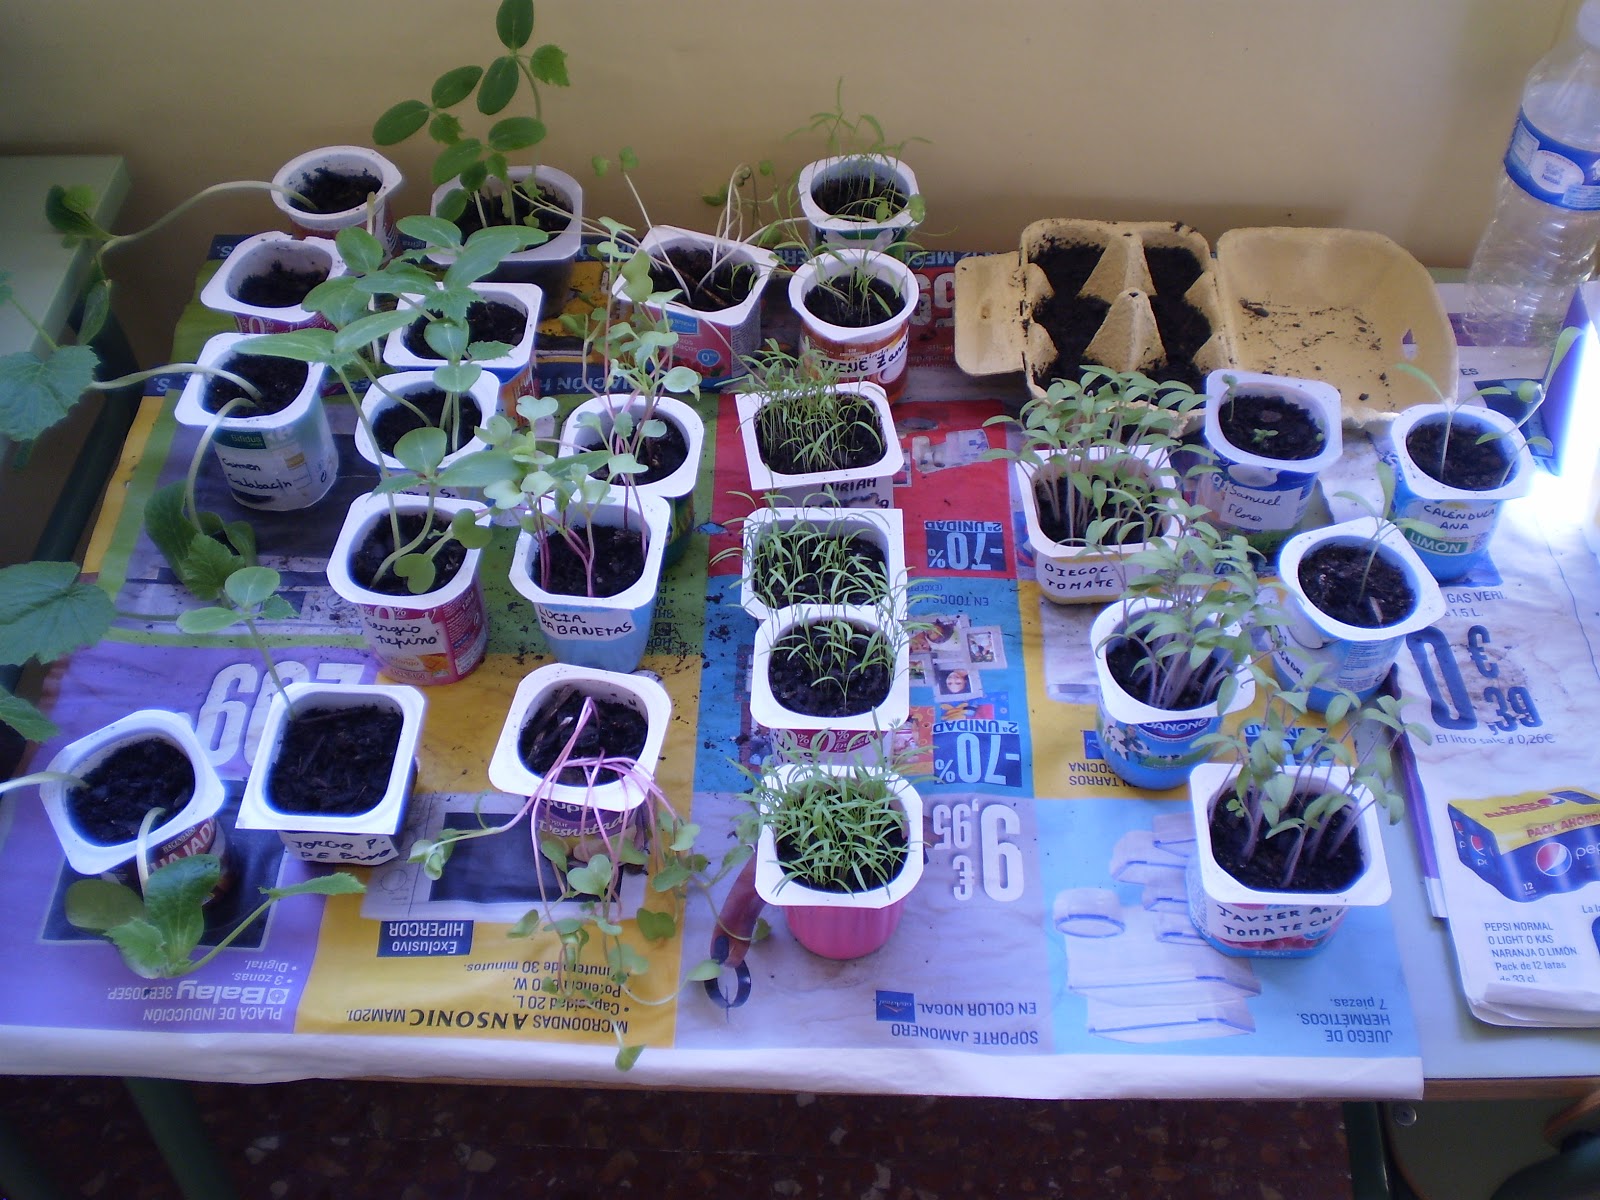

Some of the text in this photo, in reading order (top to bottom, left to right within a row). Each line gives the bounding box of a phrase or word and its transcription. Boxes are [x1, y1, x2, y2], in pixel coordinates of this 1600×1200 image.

[925, 521, 985, 532] UNIDAD
[1440, 521, 1469, 530] ANA
[927, 532, 1003, 570] -70%
[1046, 578, 1114, 590] TOMATE
[974, 596, 989, 606] EN
[1447, 593, 1472, 603] GAS
[932, 719, 999, 734] UNIDAD
[1451, 734, 1476, 744] litro
[934, 732, 1020, 785] -70%
[1069, 775, 1119, 787] TARROS
[1526, 824, 1556, 838] PACK
[980, 804, 1025, 902] 9
[952, 854, 974, 901] €
[1523, 882, 1534, 890] 12
[1217, 904, 1300, 922] JAVIER
[389, 922, 464, 937] HIPERCOR
[1224, 922, 1303, 937] TOMATE
[1484, 922, 1554, 931] PEPSI NORMAL
[1497, 935, 1524, 945] LIGHT
[1526, 935, 1533, 944] O
[1535, 935, 1554, 943] KAS
[392, 941, 457, 954] Exclusivo
[1492, 948, 1537, 958] NARANJA
[1539, 948, 1545, 956] O
[244, 959, 288, 972] Digital.
[464, 960, 519, 973] minutos.
[522, 961, 540, 973] 30
[543, 961, 559, 975] de
[1495, 961, 1567, 971] Pack de 12 latas
[231, 972, 283, 985] 3 zonas.
[512, 977, 528, 990] W.
[176, 980, 266, 1004] Balay
[512, 995, 524, 1008] L.
[527, 996, 546, 1009] 20
[1329, 997, 1385, 1010] 7 piezas.
[143, 1007, 283, 1024] PLACA DE INDUCCIÓN
[917, 1002, 1037, 1016] EN COLOR NOGAL
[409, 1008, 528, 1030] ANSONIC
[533, 1015, 629, 1035] MICROONDAS
[1296, 1013, 1391, 1028] HERMÉTICOS.
[890, 1023, 1038, 1045] SOPORTE JAMONERO
[1325, 1029, 1393, 1042] JUEGO DE
